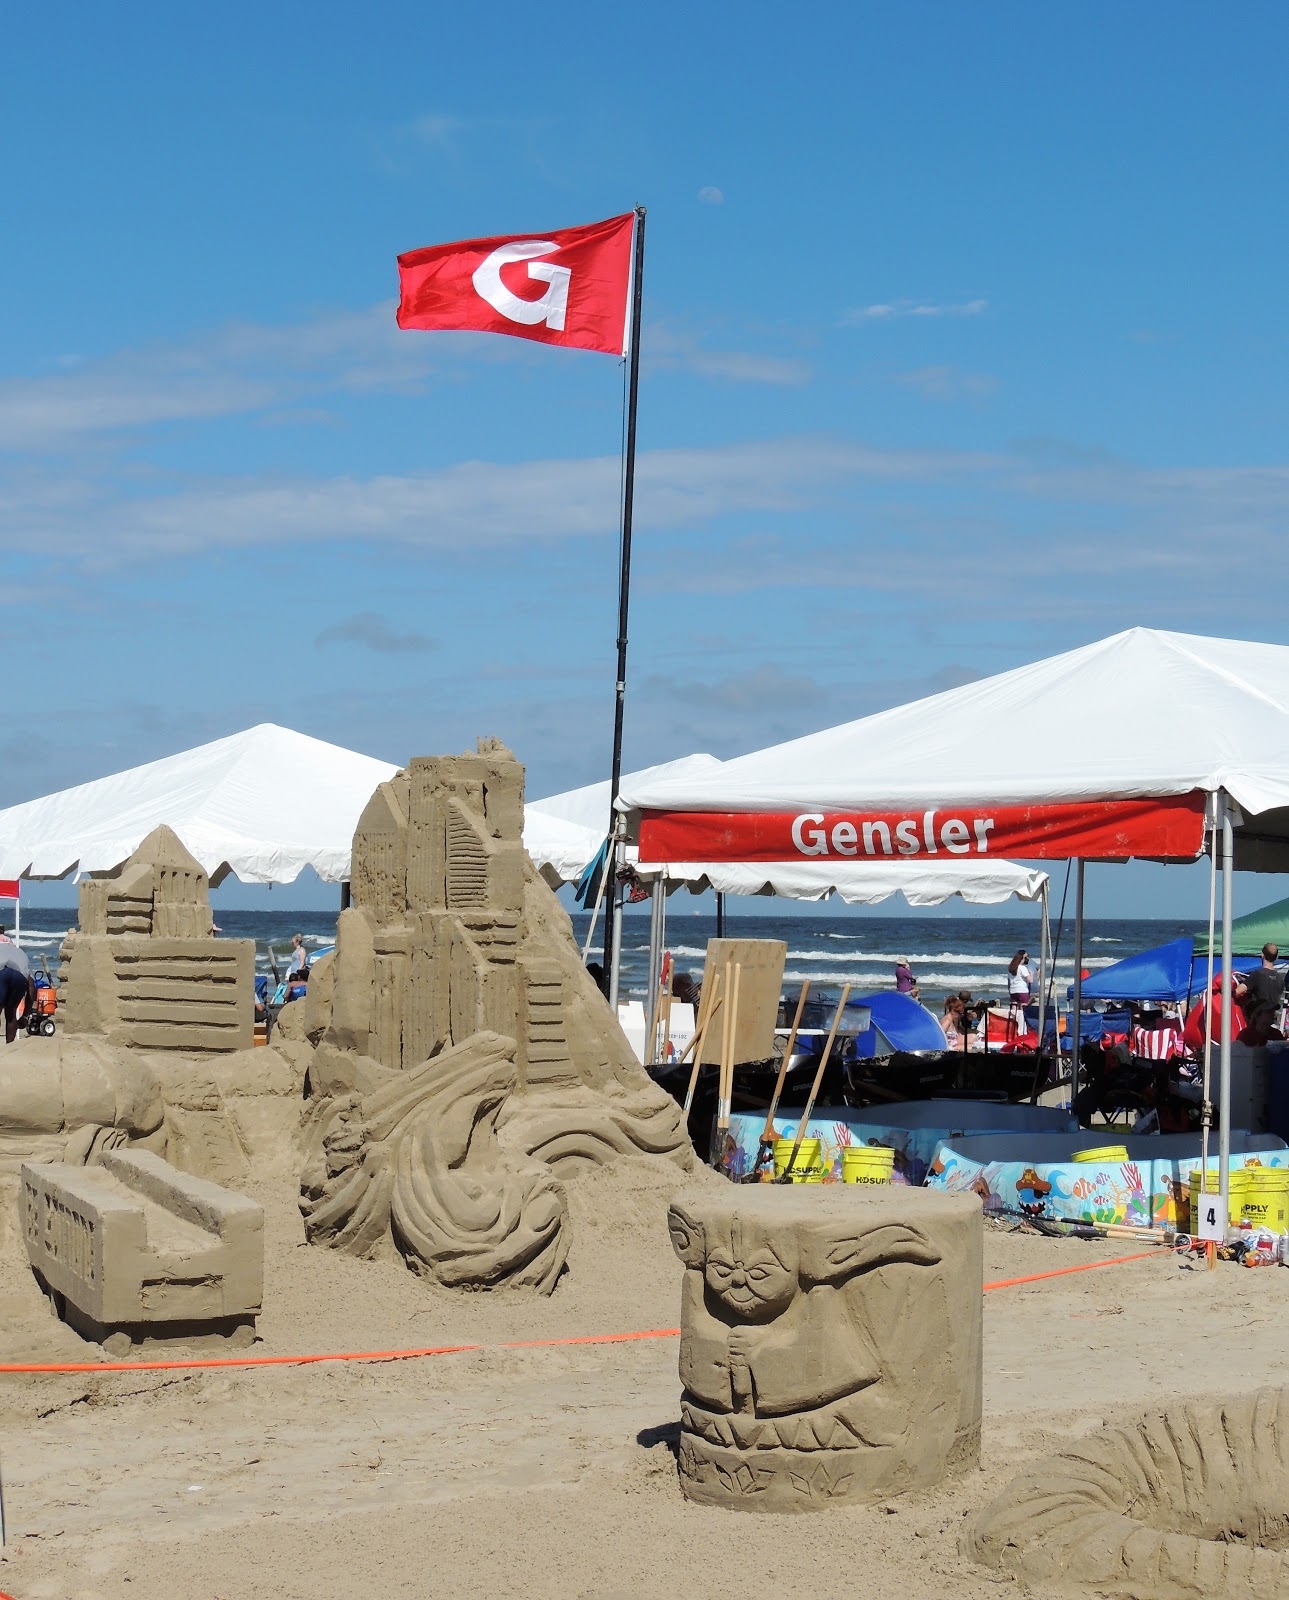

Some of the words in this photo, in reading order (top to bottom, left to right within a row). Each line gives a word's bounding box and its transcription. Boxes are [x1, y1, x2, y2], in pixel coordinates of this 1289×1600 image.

[472, 239, 572, 331] G
[791, 811, 995, 856] Gensler
[1206, 1208, 1216, 1226] 4
